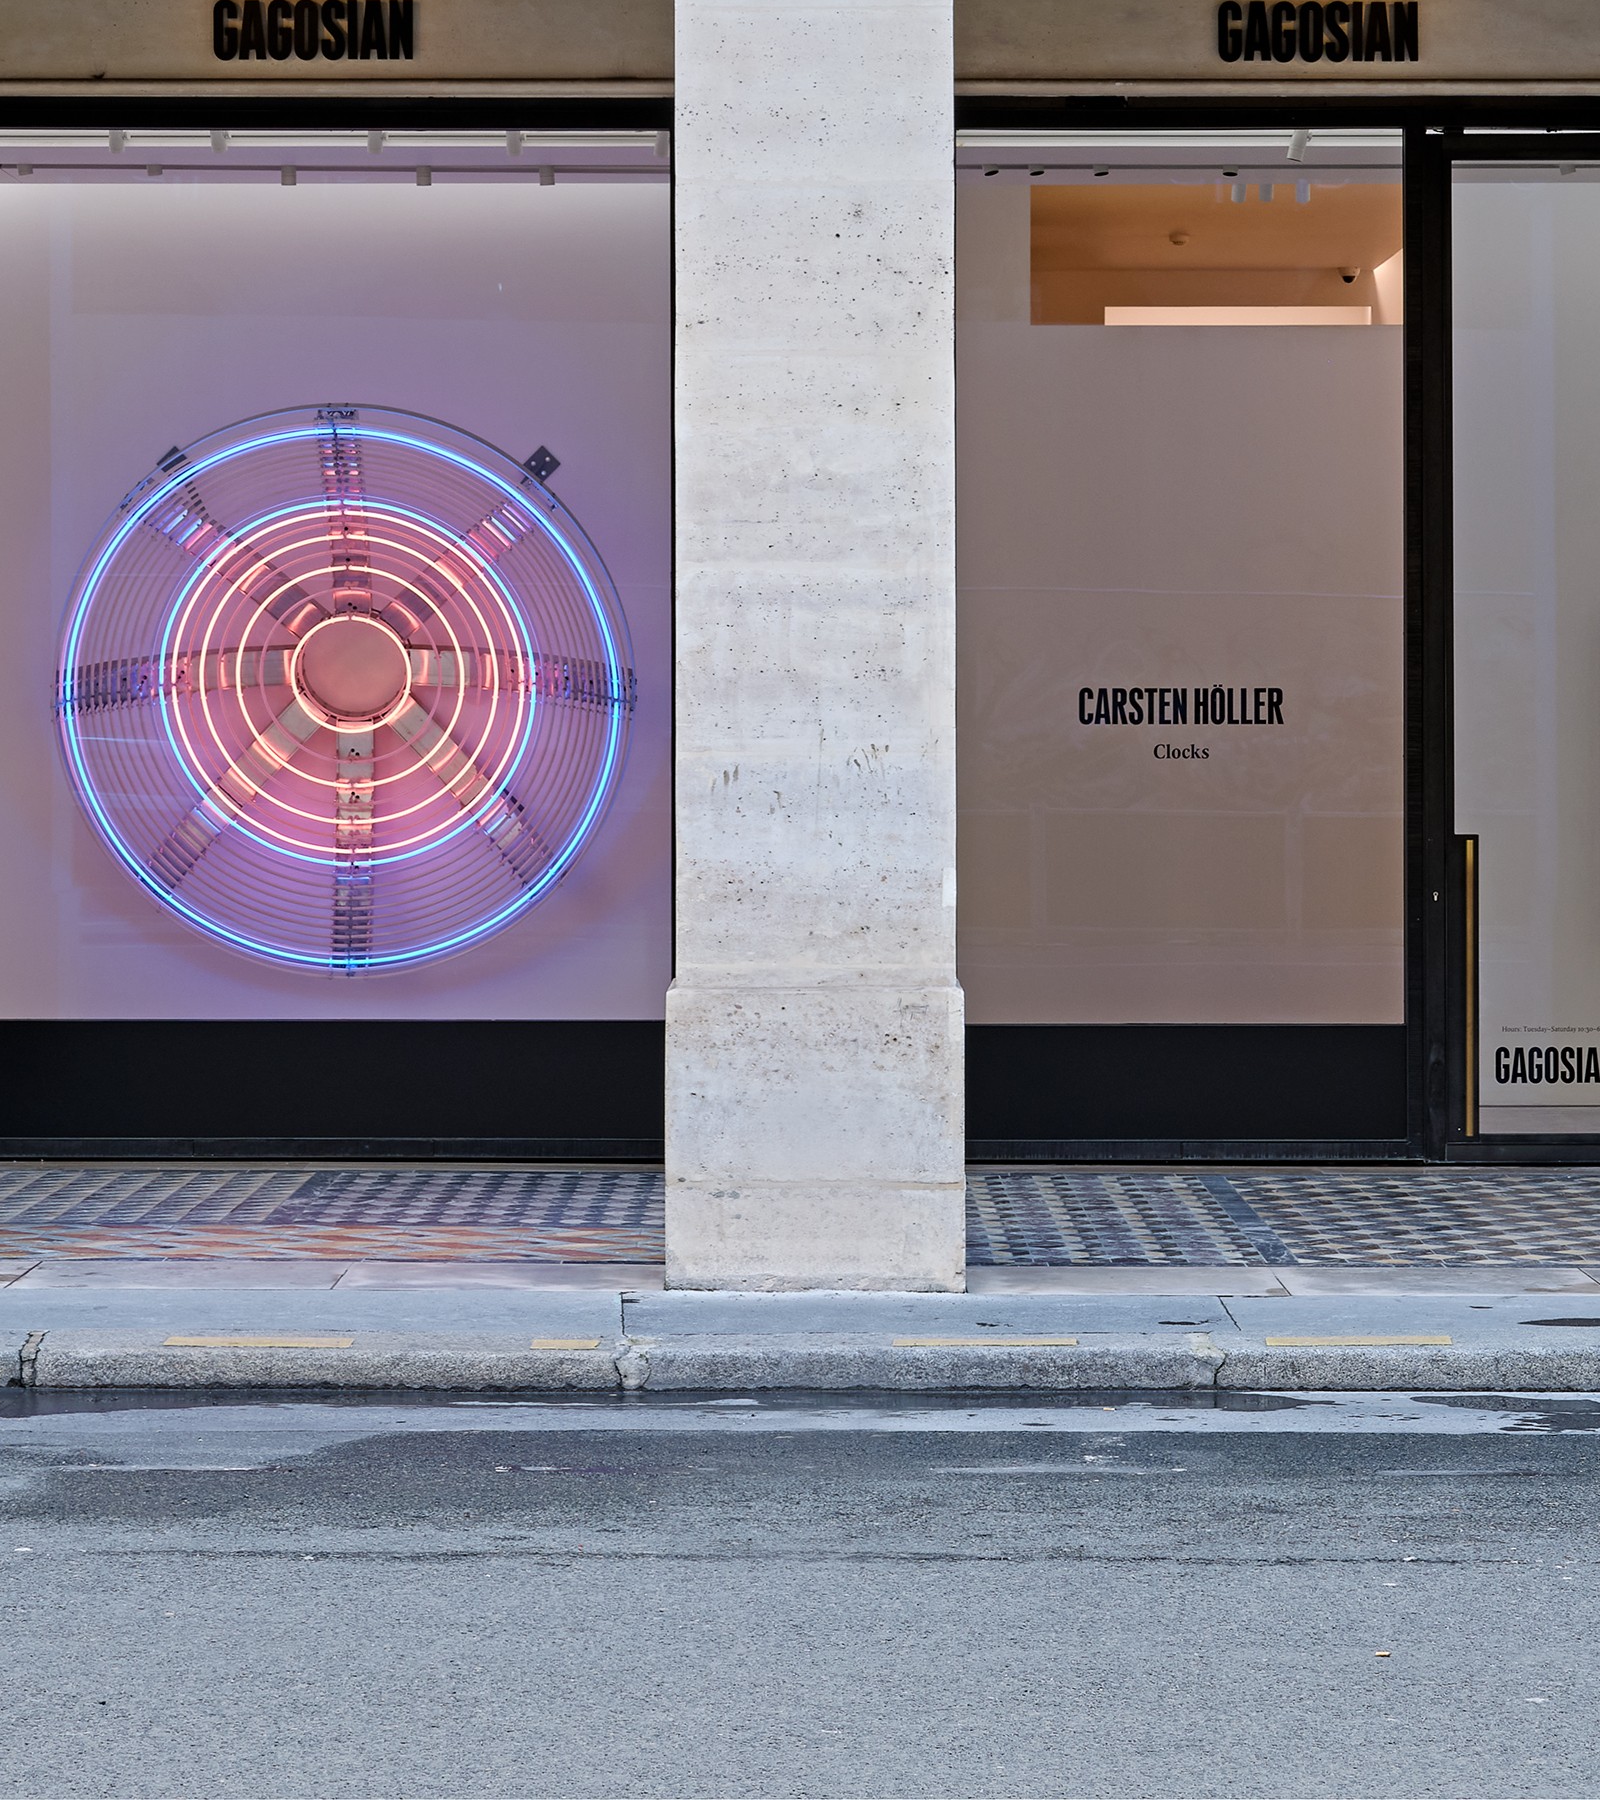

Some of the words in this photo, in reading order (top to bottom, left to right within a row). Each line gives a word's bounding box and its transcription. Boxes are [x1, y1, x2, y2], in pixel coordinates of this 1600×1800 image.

[1217, 0, 1419, 63] GAGOSIAN
[1078, 687, 1188, 725] CARSTEN
[1193, 684, 1285, 725] HÖLLER
[1153, 743, 1210, 760] Clocks
